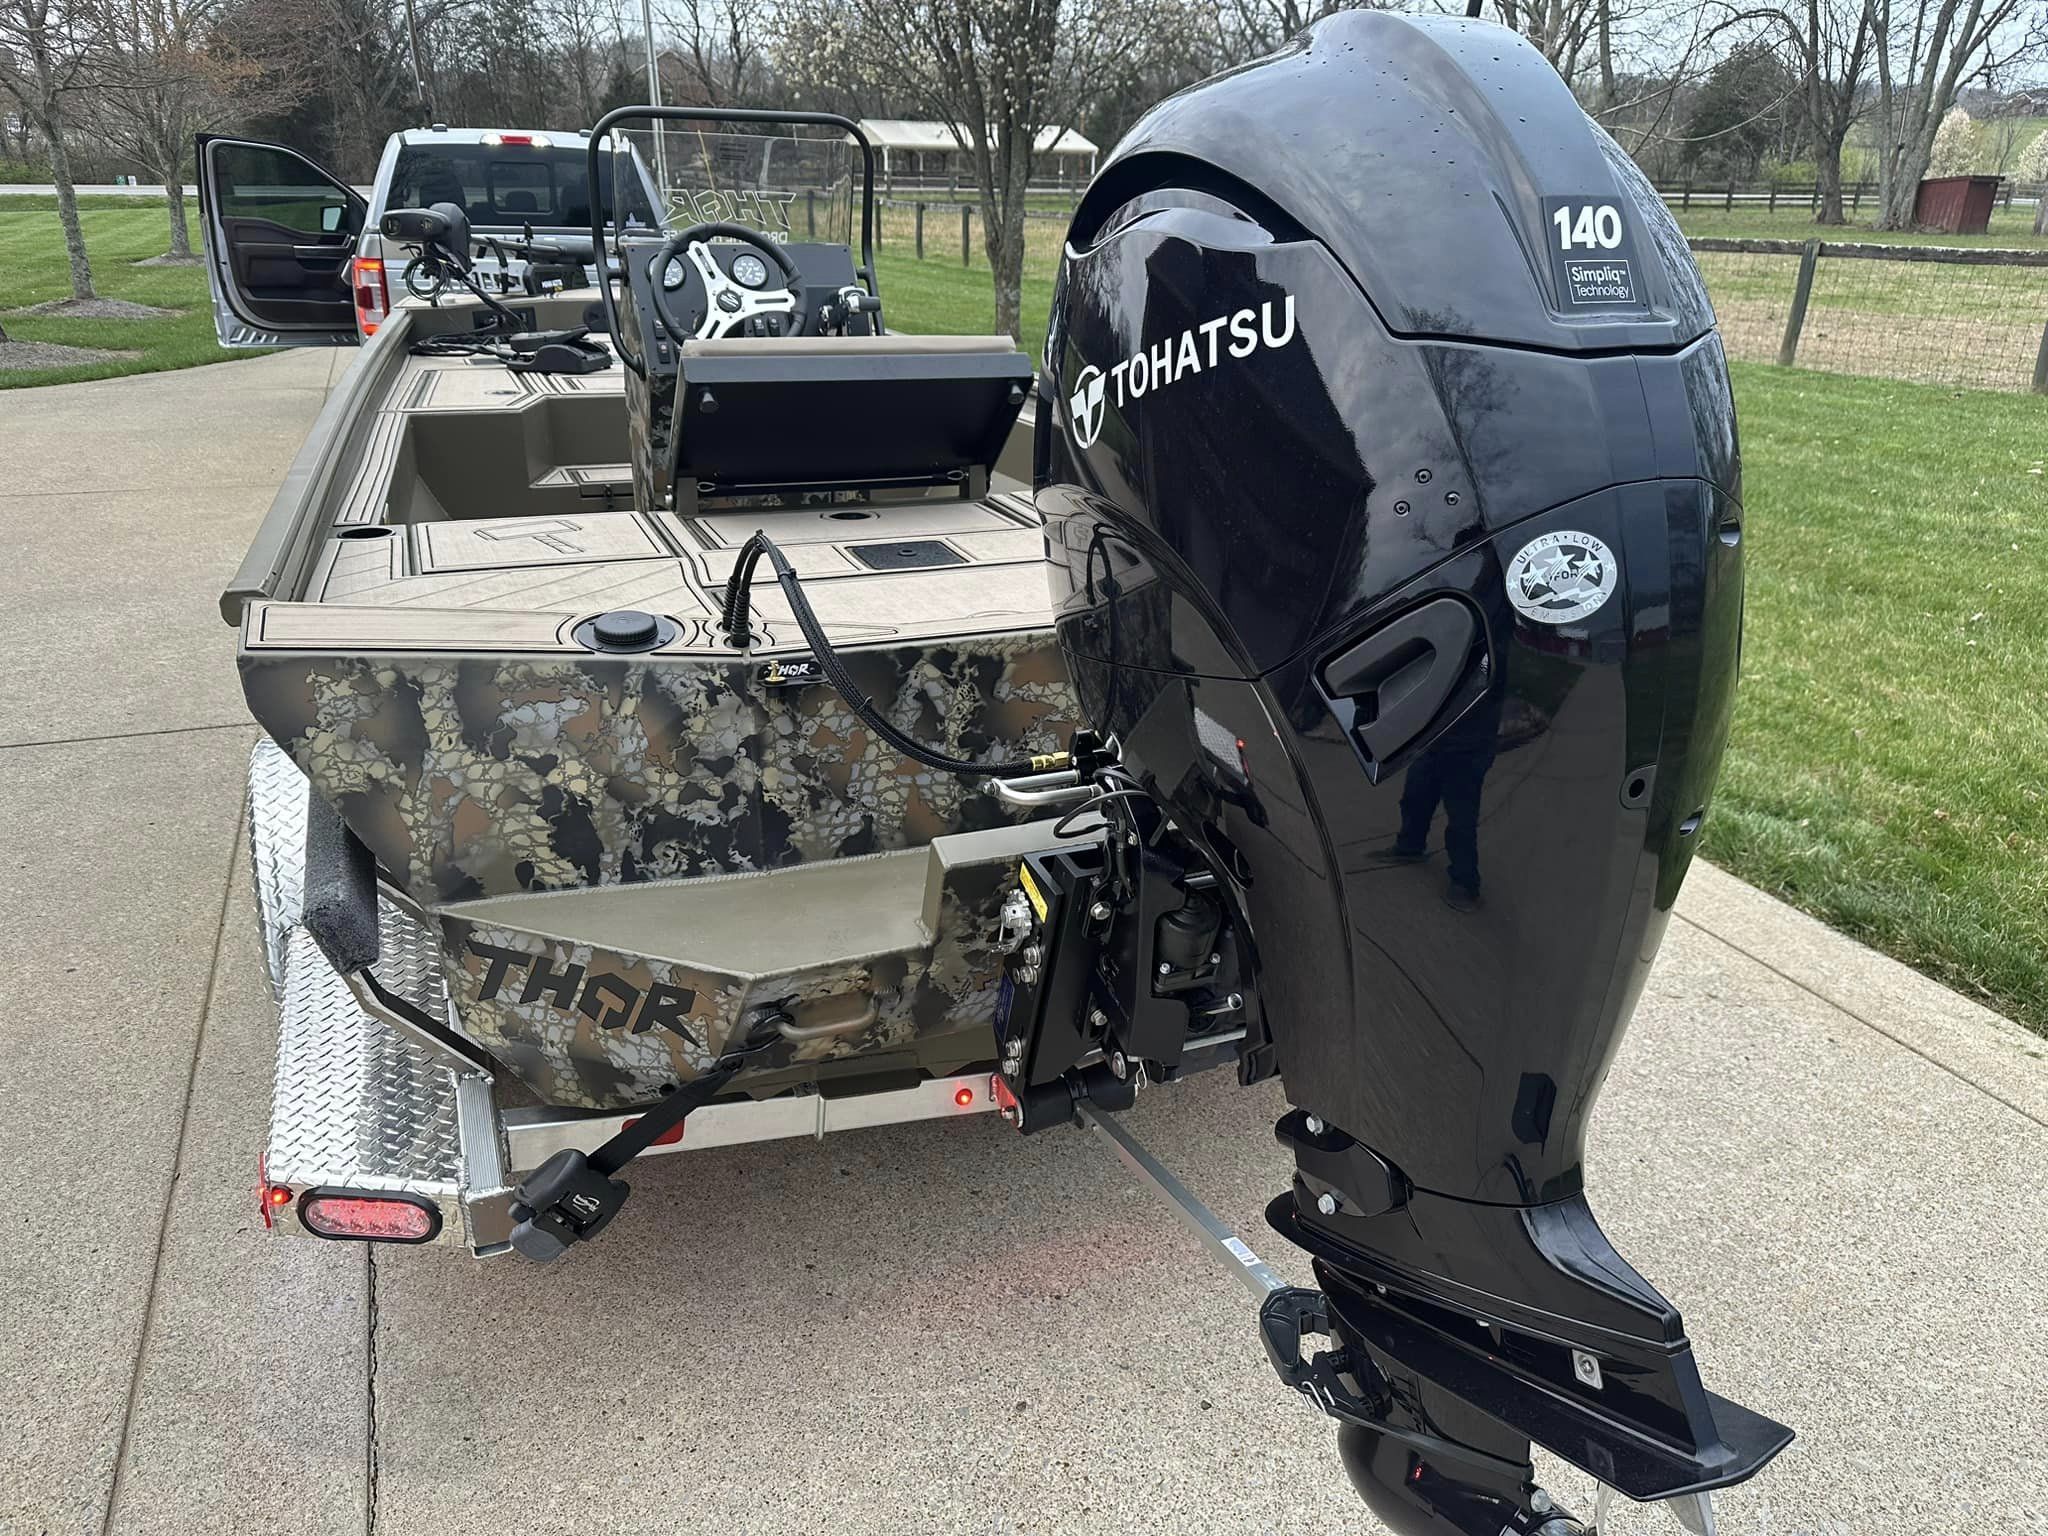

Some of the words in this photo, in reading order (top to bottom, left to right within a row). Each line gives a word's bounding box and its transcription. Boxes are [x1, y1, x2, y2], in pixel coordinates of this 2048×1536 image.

[1553, 205, 1623, 250] 140
[1574, 284, 1629, 299] Technology
[1111, 295, 1295, 409] TOHATSU
[1516, 535, 1560, 564] ULTRA
[1573, 534, 1603, 552] LOW
[465, 939, 701, 1049] THOR
